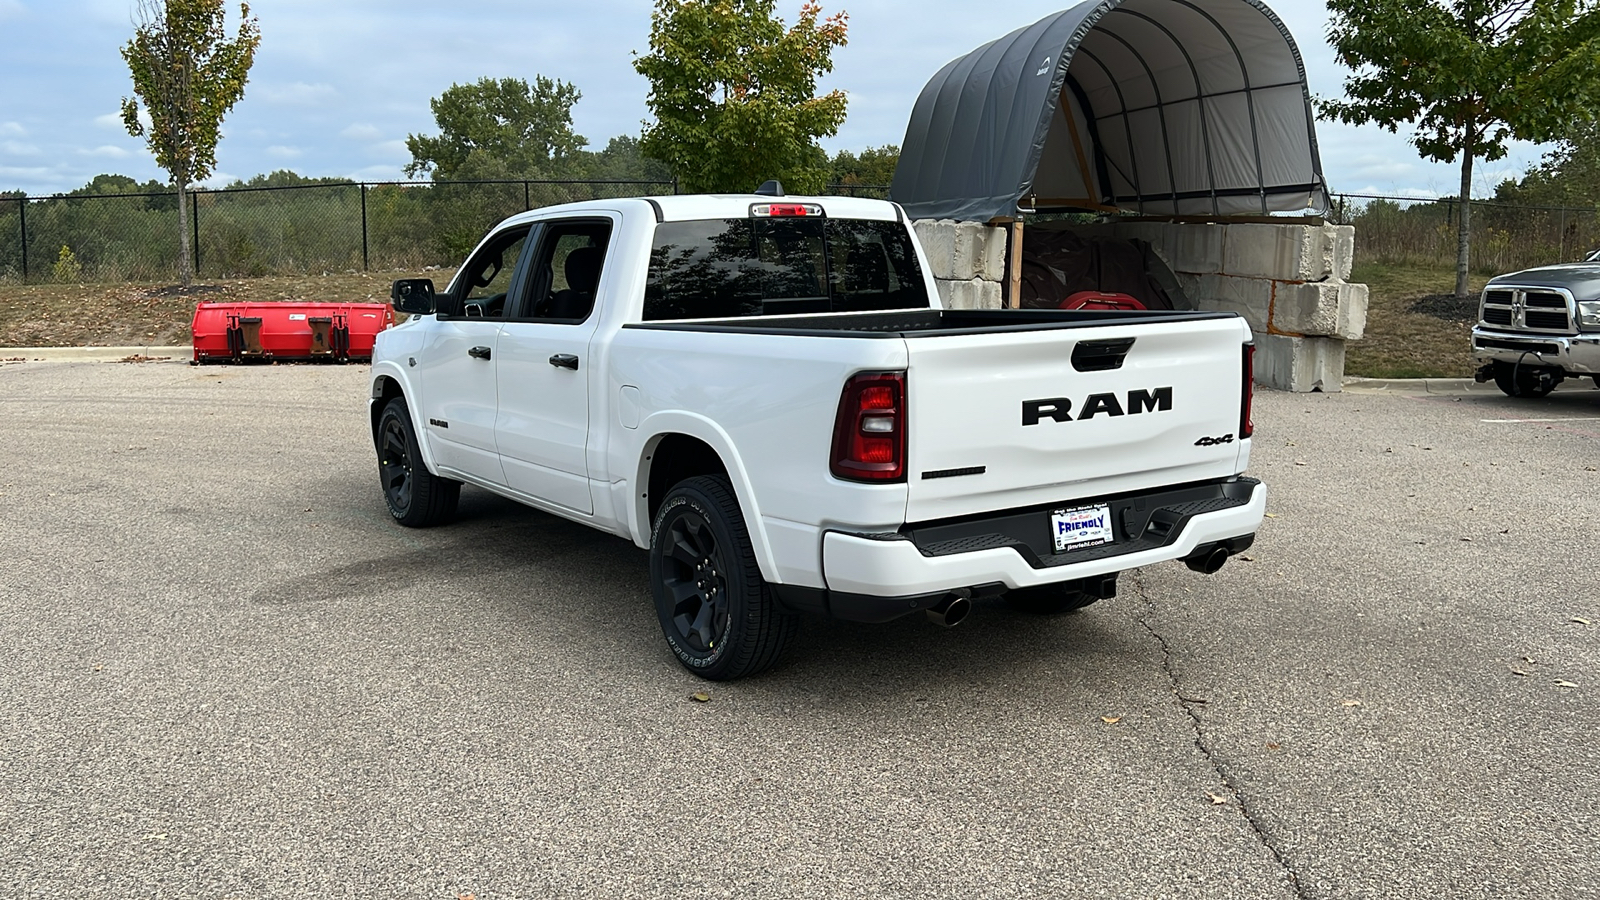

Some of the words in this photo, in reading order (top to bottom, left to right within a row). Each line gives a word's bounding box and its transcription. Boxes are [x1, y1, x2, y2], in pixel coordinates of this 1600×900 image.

[1022, 386, 1173, 426] RAM
[1193, 433, 1234, 447] 4x4
[1058, 514, 1104, 535] FRIENDLY
[1068, 540, 1104, 551] jimriehl.com
